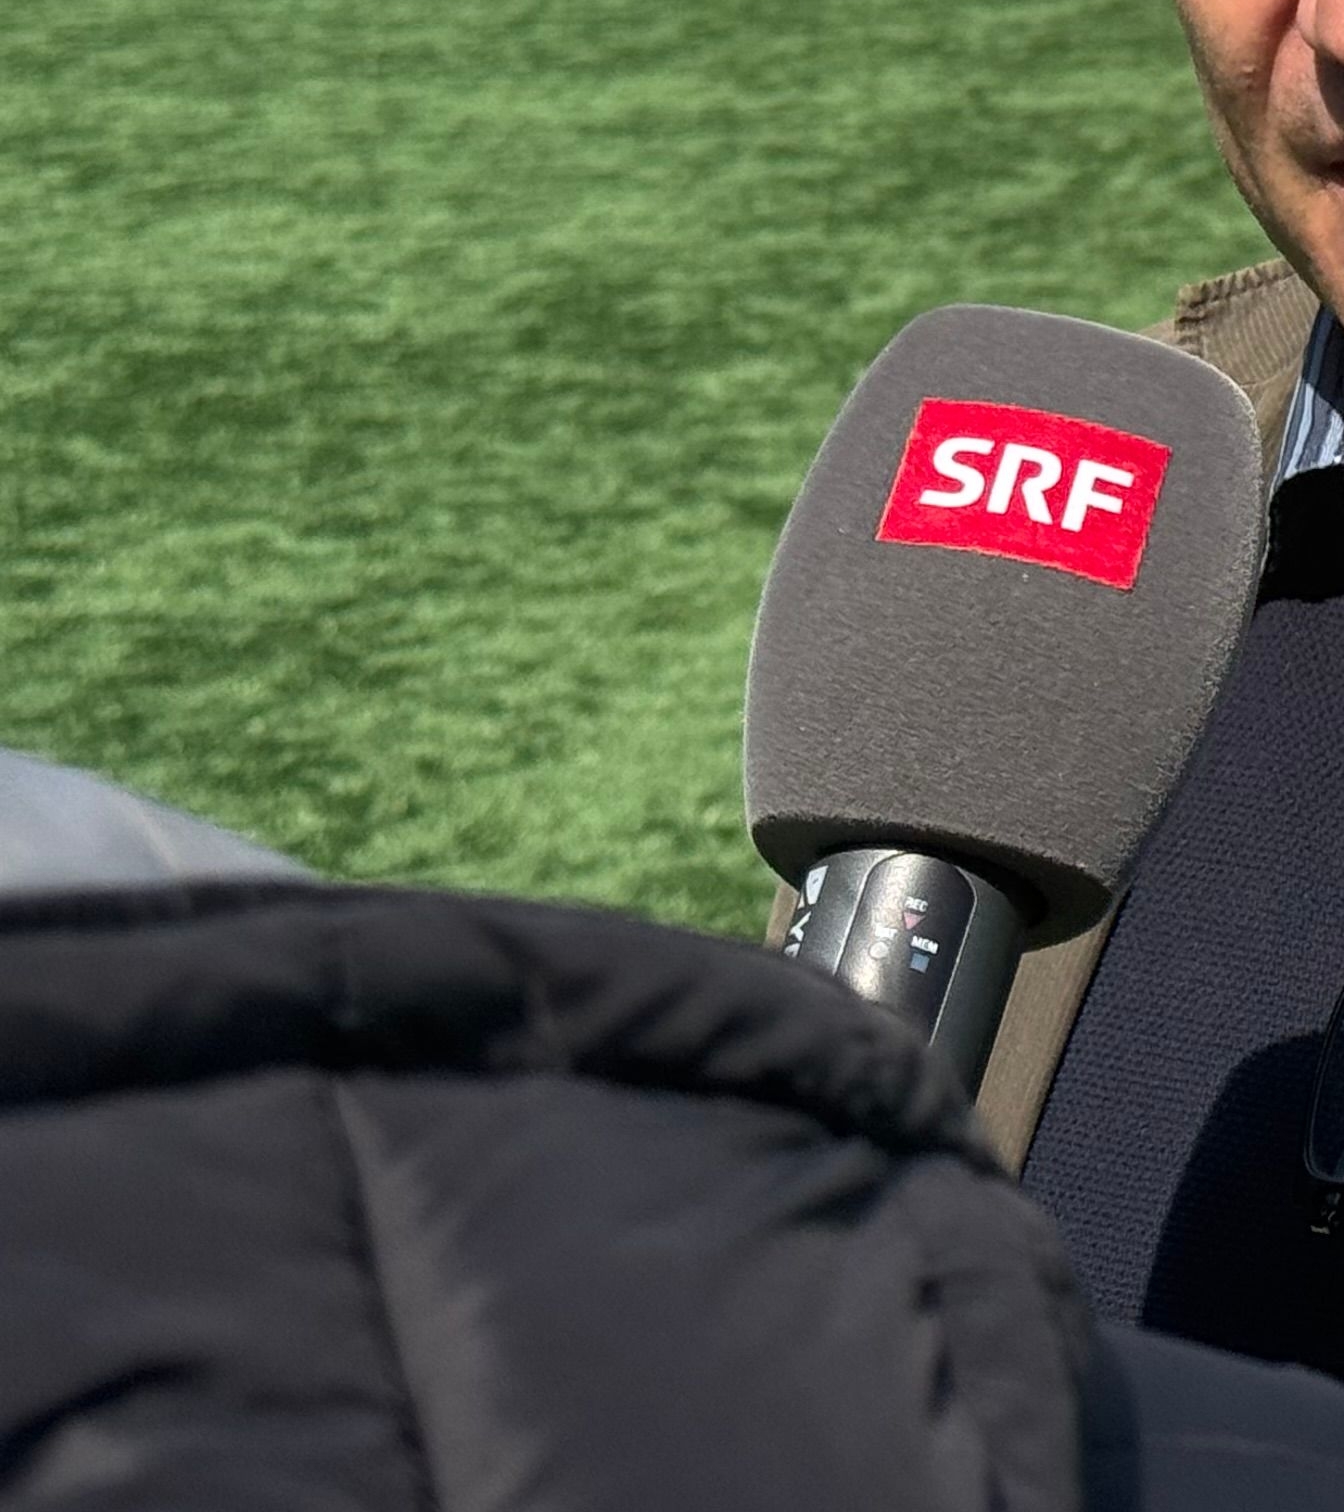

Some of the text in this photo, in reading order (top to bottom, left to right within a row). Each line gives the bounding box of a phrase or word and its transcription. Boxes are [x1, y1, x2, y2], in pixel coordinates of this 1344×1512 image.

[918, 436, 1135, 533] SRF
[904, 896, 928, 912] REC
[910, 935, 939, 954] MEM
